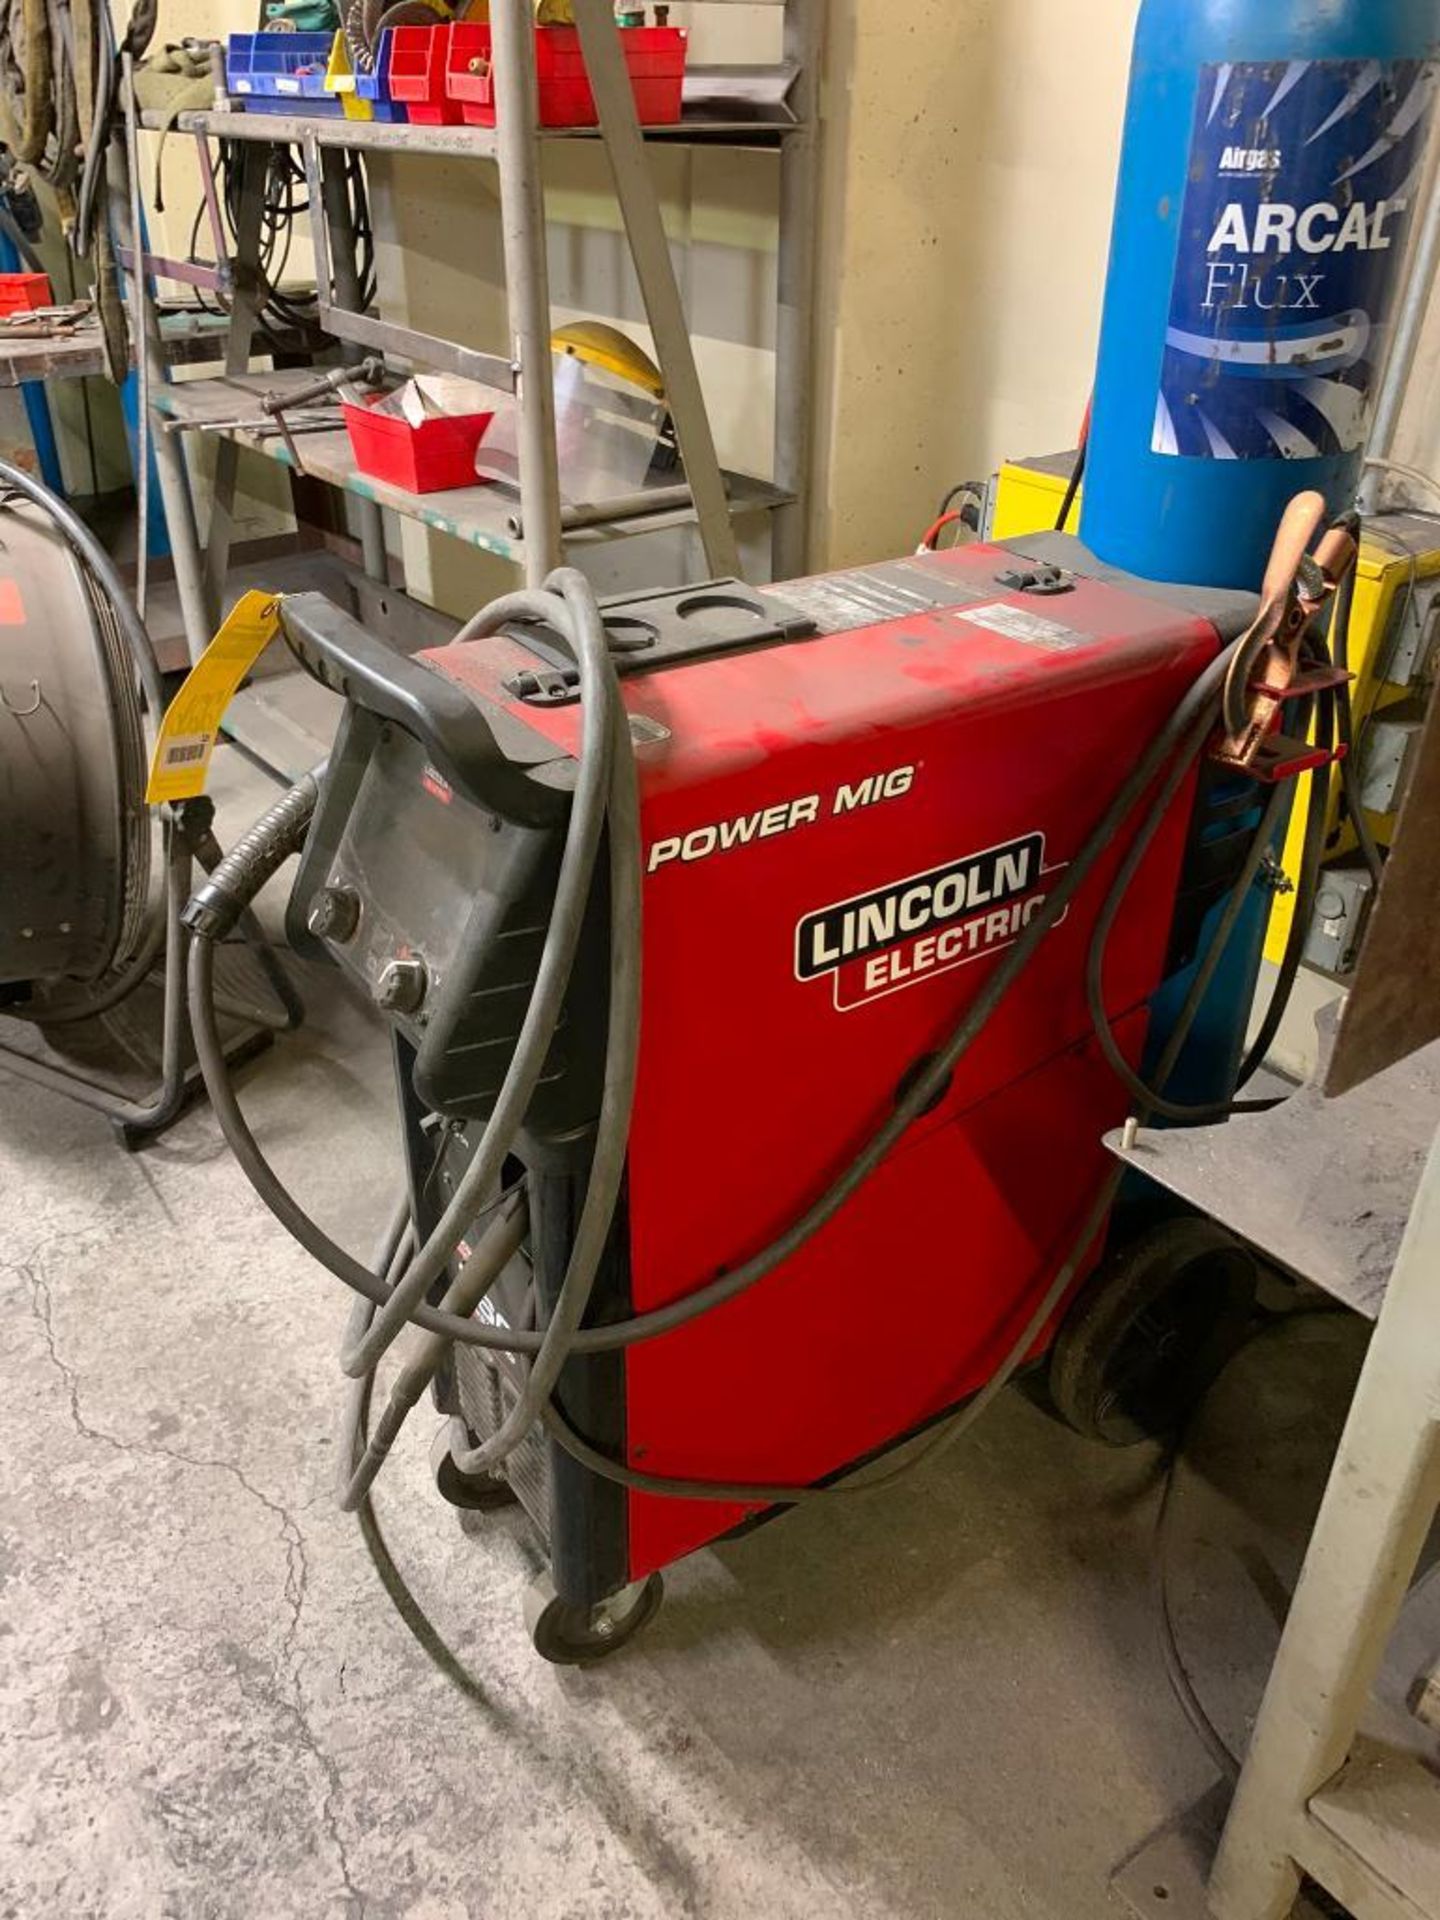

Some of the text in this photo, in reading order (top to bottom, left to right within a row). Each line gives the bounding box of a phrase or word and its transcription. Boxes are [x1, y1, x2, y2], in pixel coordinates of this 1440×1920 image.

[1218, 147, 1281, 171] Airgas
[1207, 201, 1391, 252] ARCAL
[1200, 262, 1325, 309] Flux
[647, 765, 914, 872] POWER MIG
[811, 847, 1030, 967] LINCOLN
